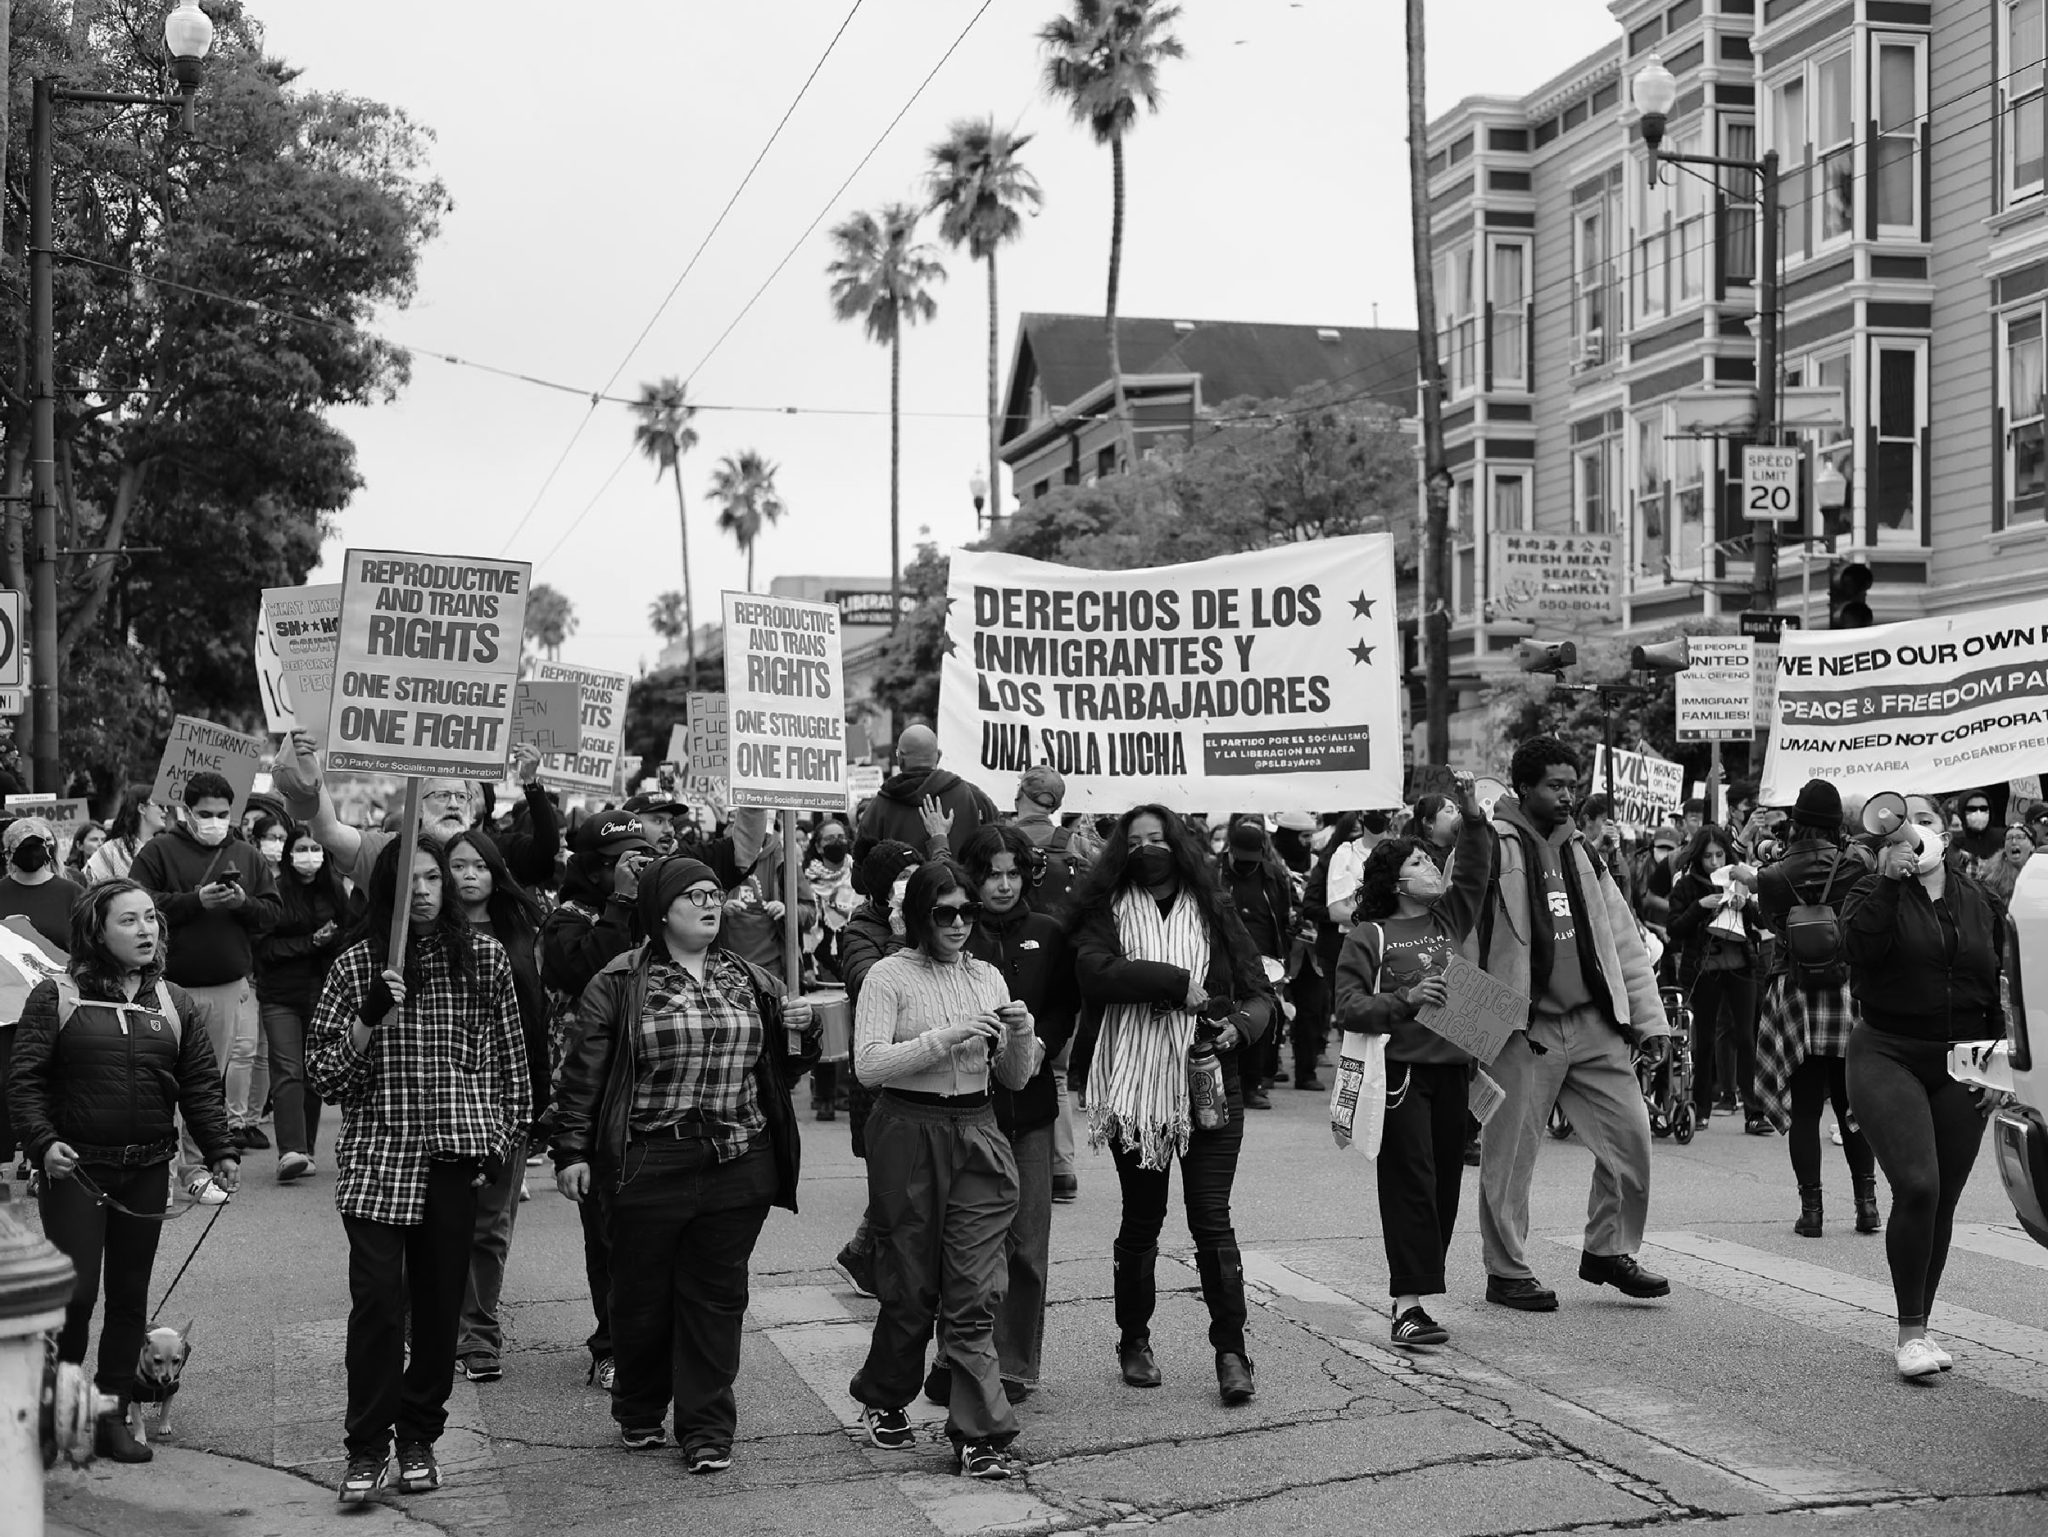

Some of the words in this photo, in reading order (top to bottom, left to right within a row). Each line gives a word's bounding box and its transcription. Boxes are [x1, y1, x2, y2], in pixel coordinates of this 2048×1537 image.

[1748, 455, 1793, 468] SPEED
[1752, 471, 1789, 481] LIMIT
[1750, 485, 1791, 510] 20
[1507, 554, 1561, 564] FRESH
[1567, 555, 1610, 565] MEAT
[361, 559, 520, 594] REPRODUCTIVE
[375, 587, 423, 613] AND
[429, 591, 499, 618] TRANS
[735, 601, 836, 635] REPRODUCTIVE
[974, 585, 1180, 633] DERECHOS
[1192, 588, 1240, 629] DE
[1251, 584, 1322, 629] LOS
[367, 614, 500, 663] RIGHTS
[749, 628, 778, 651] AND
[781, 631, 826, 657] TRANS
[1818, 649, 1891, 676] NEED
[1897, 643, 1958, 666] OUR
[1962, 627, 2035, 657] OWN
[974, 631, 1224, 678] INMIGRANTES
[1234, 634, 1256, 673] Y
[343, 671, 390, 699] ONE
[394, 676, 507, 708] STRUGGLE
[541, 665, 626, 691] REPRODUCTIVE
[747, 654, 831, 699] RIGHTS
[978, 672, 1045, 717] LOS
[1053, 675, 1331, 720] TRABAJADORES
[1682, 697, 1750, 705] IMMIGRANT
[1780, 699, 1858, 719] PEACE
[1862, 697, 1875, 714] &
[1881, 675, 2002, 713] FREEDOM
[340, 705, 408, 745] ONE
[413, 711, 504, 751] FIGHT
[736, 709, 767, 734] ONE
[769, 712, 842, 740] STRUGGLE
[1682, 711, 1750, 720] FAMILIES!
[175, 723, 261, 758] IMMIGRANTS
[981, 720, 1032, 772] UNA
[1041, 728, 1102, 776] SOLA
[1107, 731, 1188, 776] LUCHA
[1206, 739, 1218, 747] EL
[1221, 738, 1266, 747] PARTIDO
[1269, 737, 1290, 745] POR
[1308, 732, 1368, 743] SOCIALISMO
[1214, 751, 1222, 759] Y
[1224, 750, 1237, 758] LA
[1240, 748, 1302, 758] LIBERACION
[1305, 746, 1326, 755] BAY
[1329, 745, 1356, 754] AREA
[1780, 737, 1836, 752] UMAN
[1838, 733, 1892, 752] NEED
[1895, 731, 1938, 746] NOT
[184, 746, 225, 771] MAKE
[350, 758, 373, 769] Party
[376, 760, 388, 769] for
[391, 761, 436, 773] Socialism
[437, 764, 455, 774] and
[457, 766, 501, 777] Liberation
[563, 754, 612, 778] FIGHT
[737, 742, 781, 778] ONE
[786, 746, 842, 782] FIGHT
[1254, 758, 1322, 769] @PSLBayArea
[1447, 963, 1523, 1025] CHINGA
[1459, 1000, 1481, 1023] LA
[1422, 1004, 1501, 1061] MIGRA!
